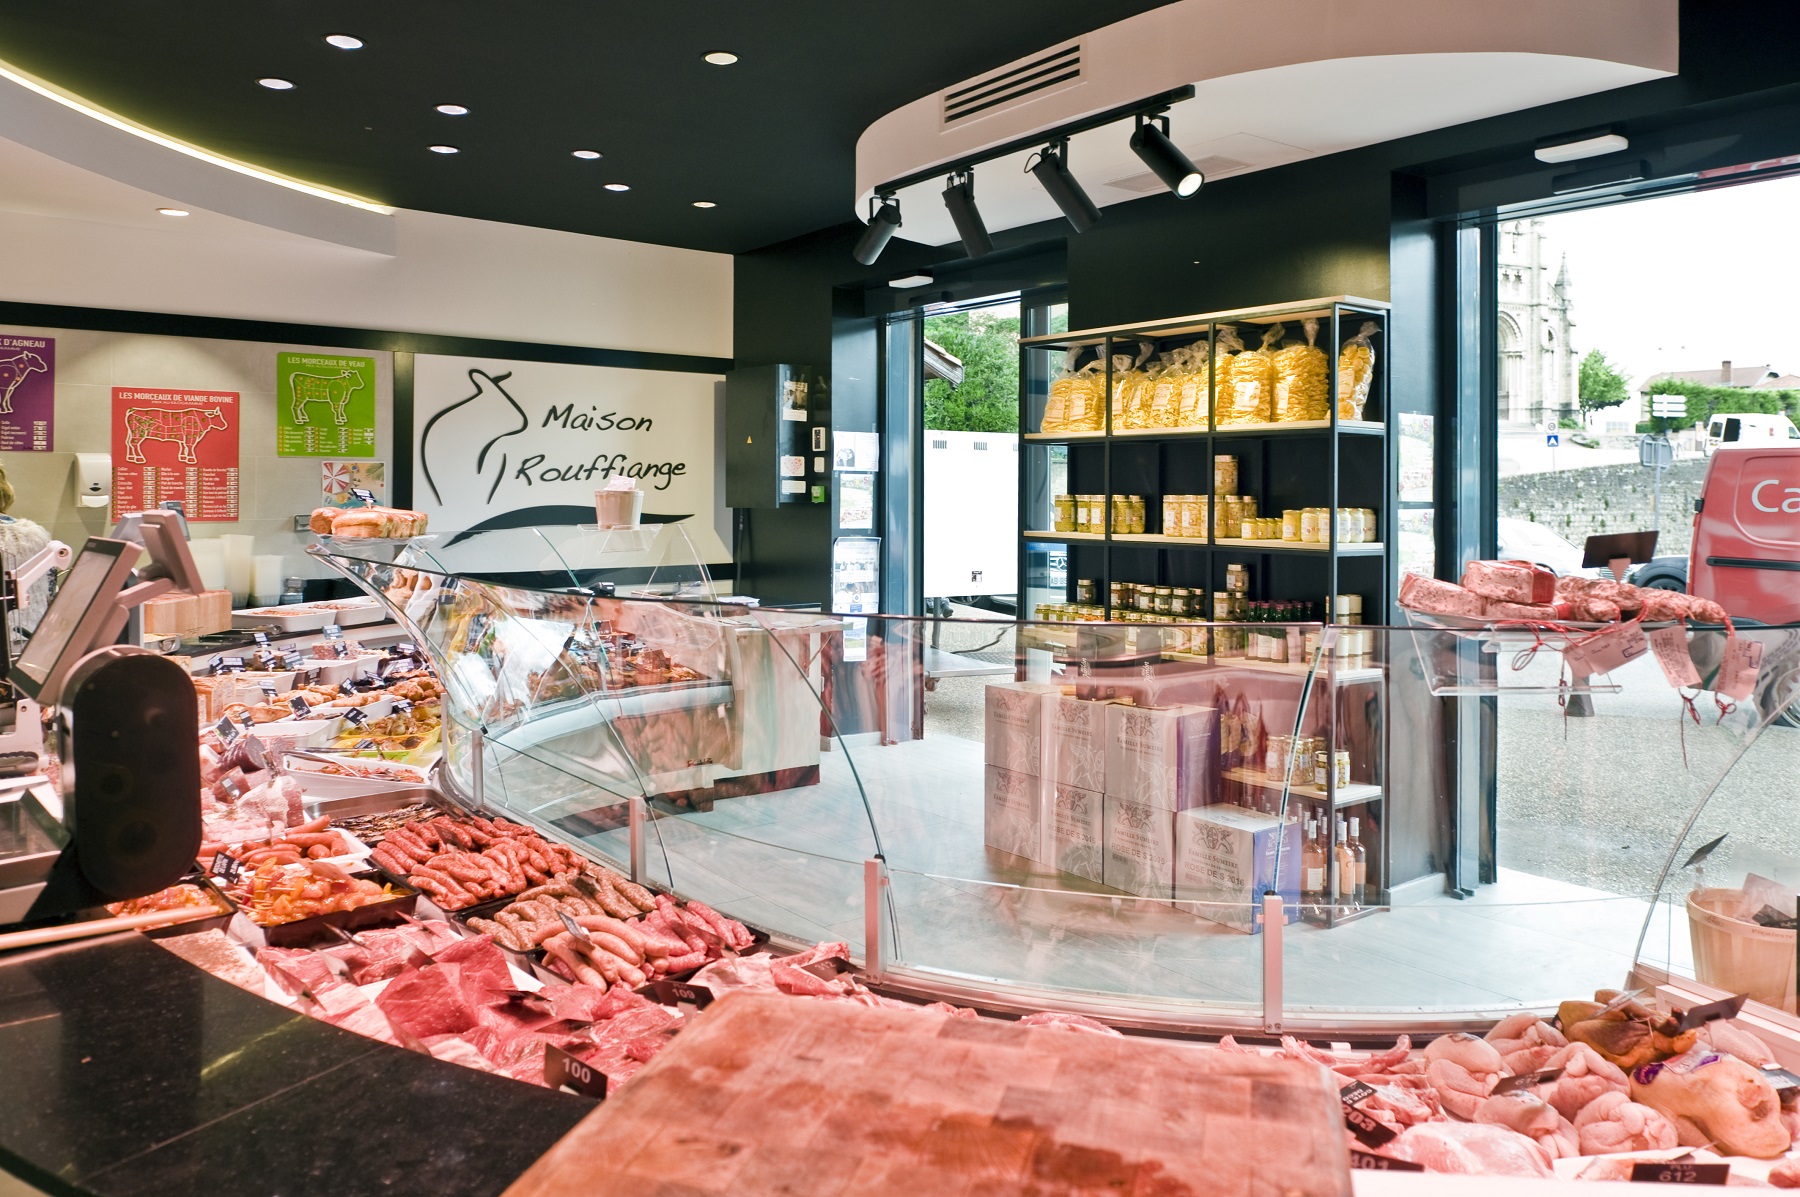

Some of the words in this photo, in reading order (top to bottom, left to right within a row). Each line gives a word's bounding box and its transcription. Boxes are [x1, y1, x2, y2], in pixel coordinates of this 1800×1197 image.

[4, 339, 46, 348] D'AGNEAU
[302, 358, 337, 366] MORCEAUX
[349, 360, 366, 368] VEAU
[134, 392, 172, 401] MORCEAUX
[184, 394, 208, 403] VIANDE
[209, 395, 234, 404] BOVINE
[542, 403, 653, 432] Maison
[515, 453, 687, 490] Rouffiange
[1751, 479, 1800, 513] Ca
[1111, 842, 1130, 854] ROSE
[1131, 848, 1141, 859] DE
[1188, 847, 1212, 861] FAMILLE
[1213, 855, 1239, 869] SUMEIRE
[1184, 861, 1205, 874] ROSE
[1206, 869, 1217, 878] DE
[1227, 875, 1245, 886] 2016
[672, 988, 696, 999] 109
[562, 1057, 591, 1084] 100
[1659, 1170, 1697, 1182] 612
